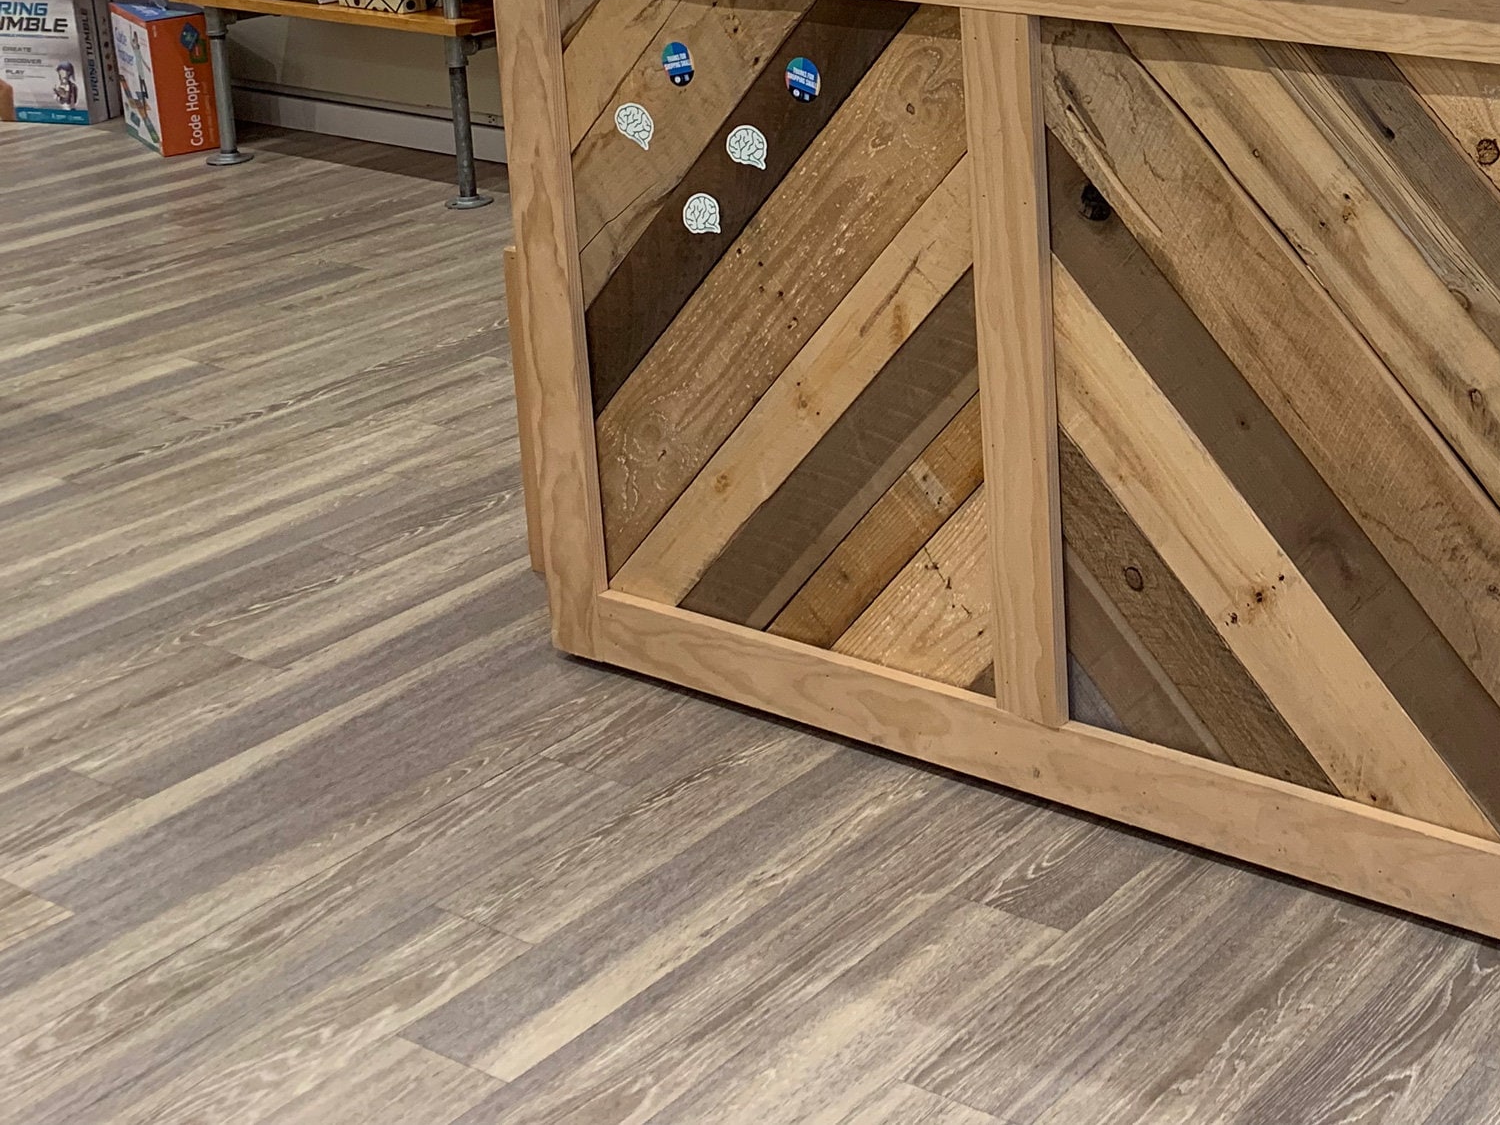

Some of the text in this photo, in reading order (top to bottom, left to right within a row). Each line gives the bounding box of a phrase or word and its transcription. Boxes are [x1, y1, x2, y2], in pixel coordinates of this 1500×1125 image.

[81, 7, 100, 103] TURING TUMBLE
[184, 66, 204, 147] Code Hopper
